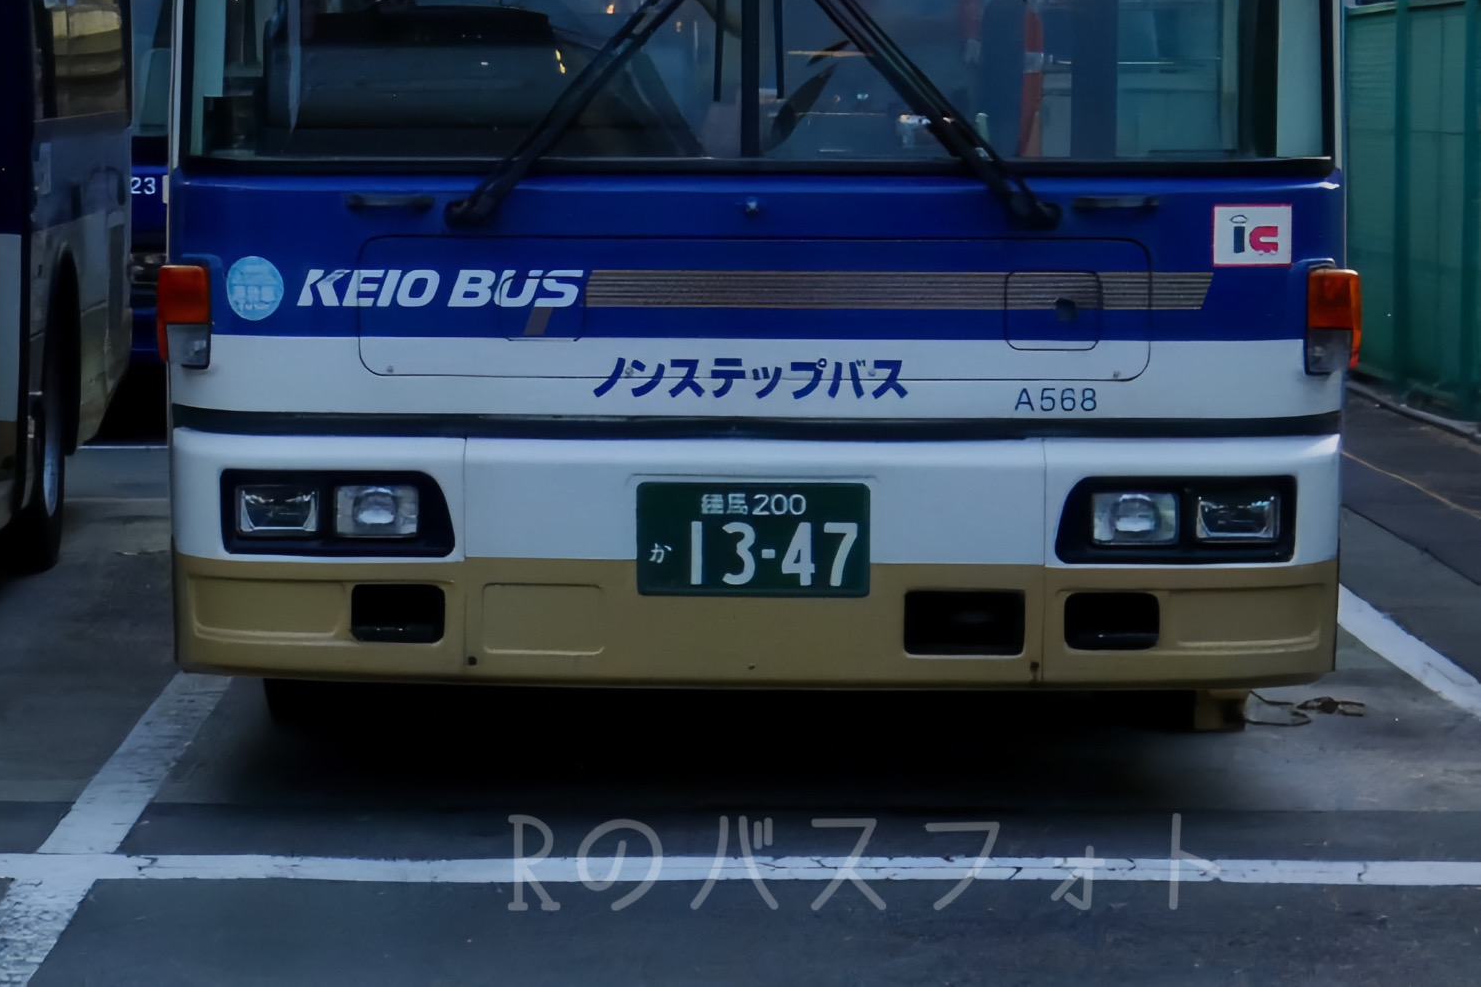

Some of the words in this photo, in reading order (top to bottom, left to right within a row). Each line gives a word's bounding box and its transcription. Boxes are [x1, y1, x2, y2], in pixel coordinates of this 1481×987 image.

[297, 269, 440, 307] KEIO
[447, 269, 584, 307] BUS
[593, 357, 909, 400] ノンステップバス
[1014, 387, 1097, 412] A568
[690, 521, 859, 587] 13-47
